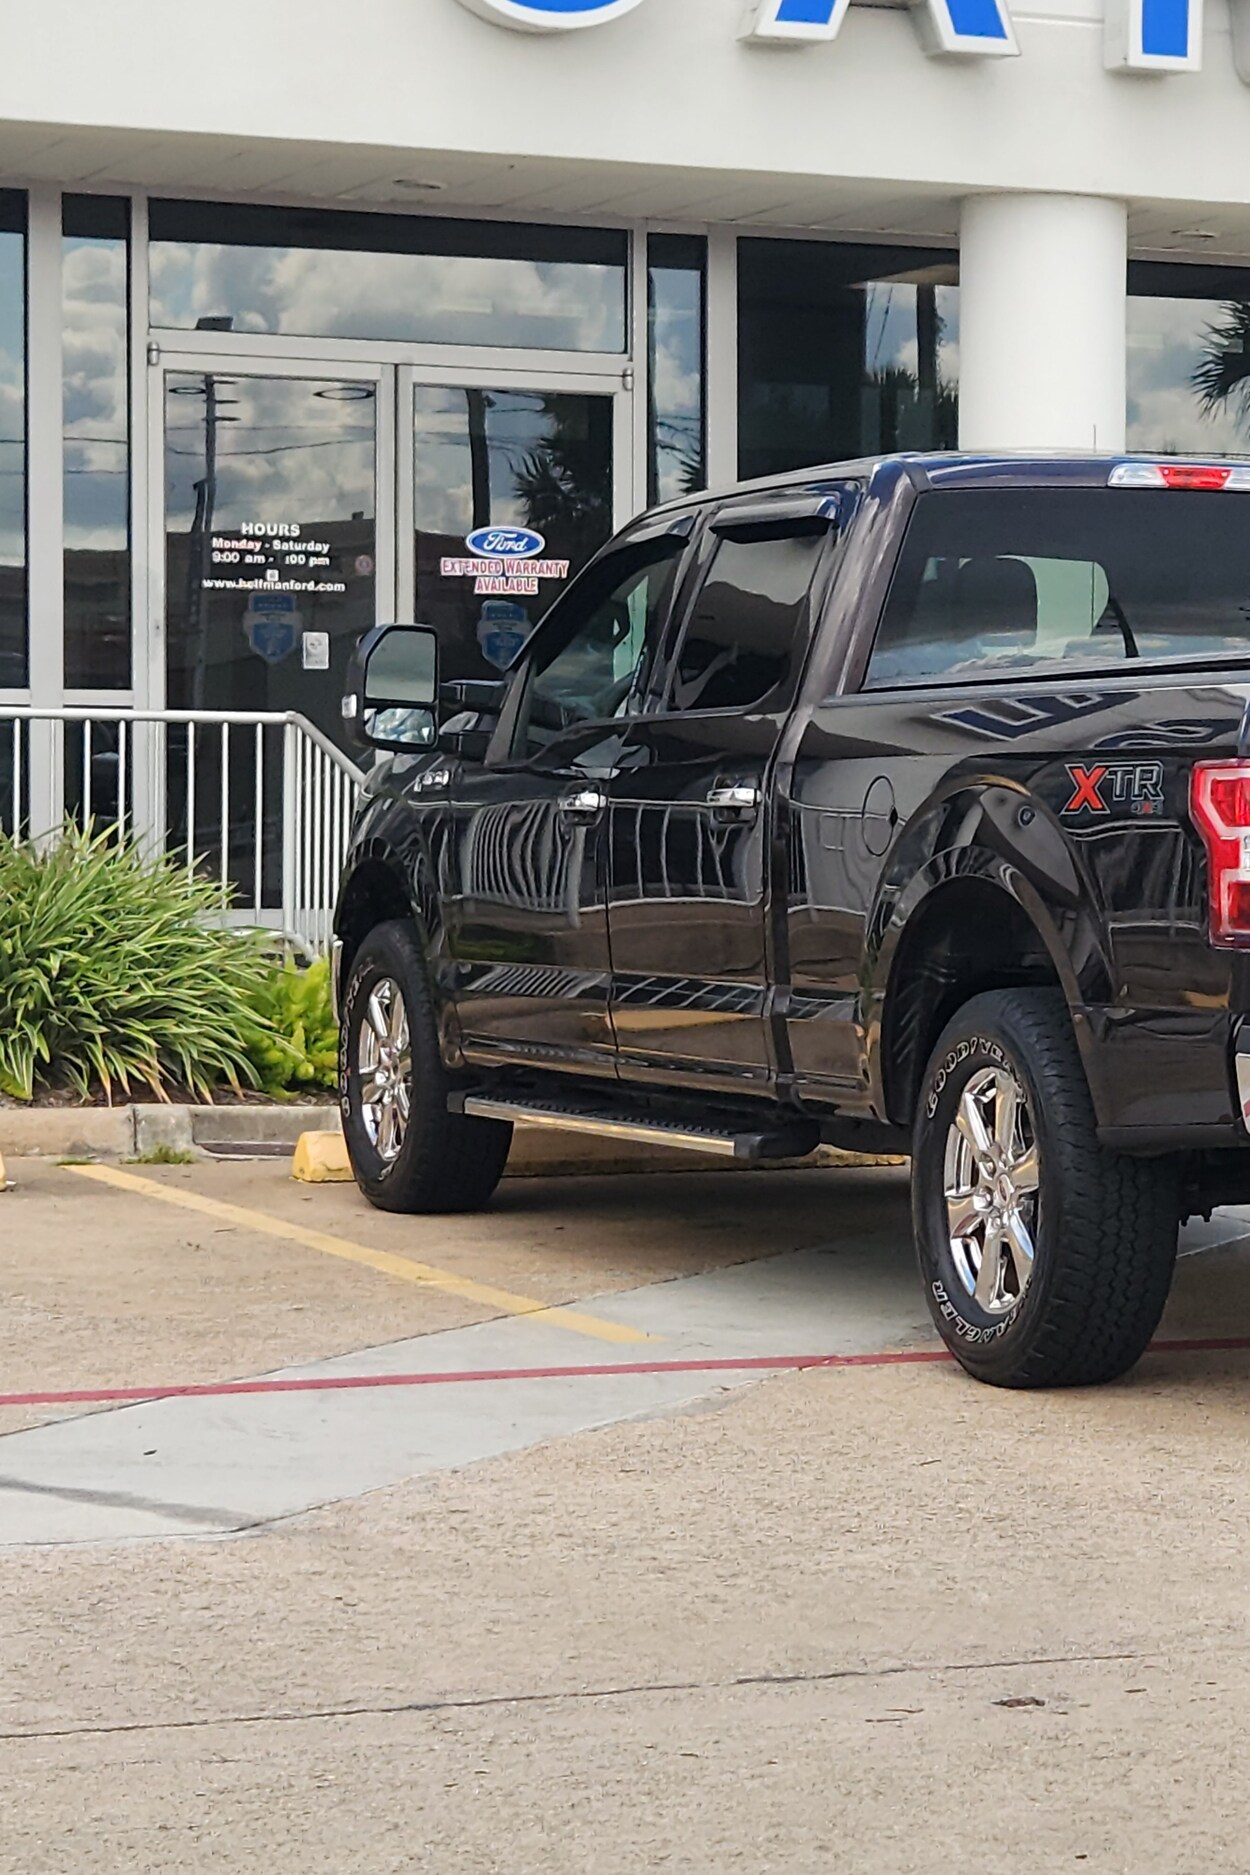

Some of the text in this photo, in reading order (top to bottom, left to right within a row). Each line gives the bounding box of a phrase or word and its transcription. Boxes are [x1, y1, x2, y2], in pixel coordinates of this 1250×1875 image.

[241, 522, 301, 537] HOURS
[212, 537, 262, 552] Monday
[272, 539, 330, 554] Saturday
[483, 531, 529, 552] Ford
[212, 552, 240, 563] 9:00
[244, 554, 266, 564] am
[309, 556, 330, 567] pm
[442, 559, 569, 576] EXTENDED WARRANTY
[202, 578, 346, 592] www.helfmanford.com
[476, 577, 537, 593] AVAILABLE
[1061, 761, 1164, 814] XTR
